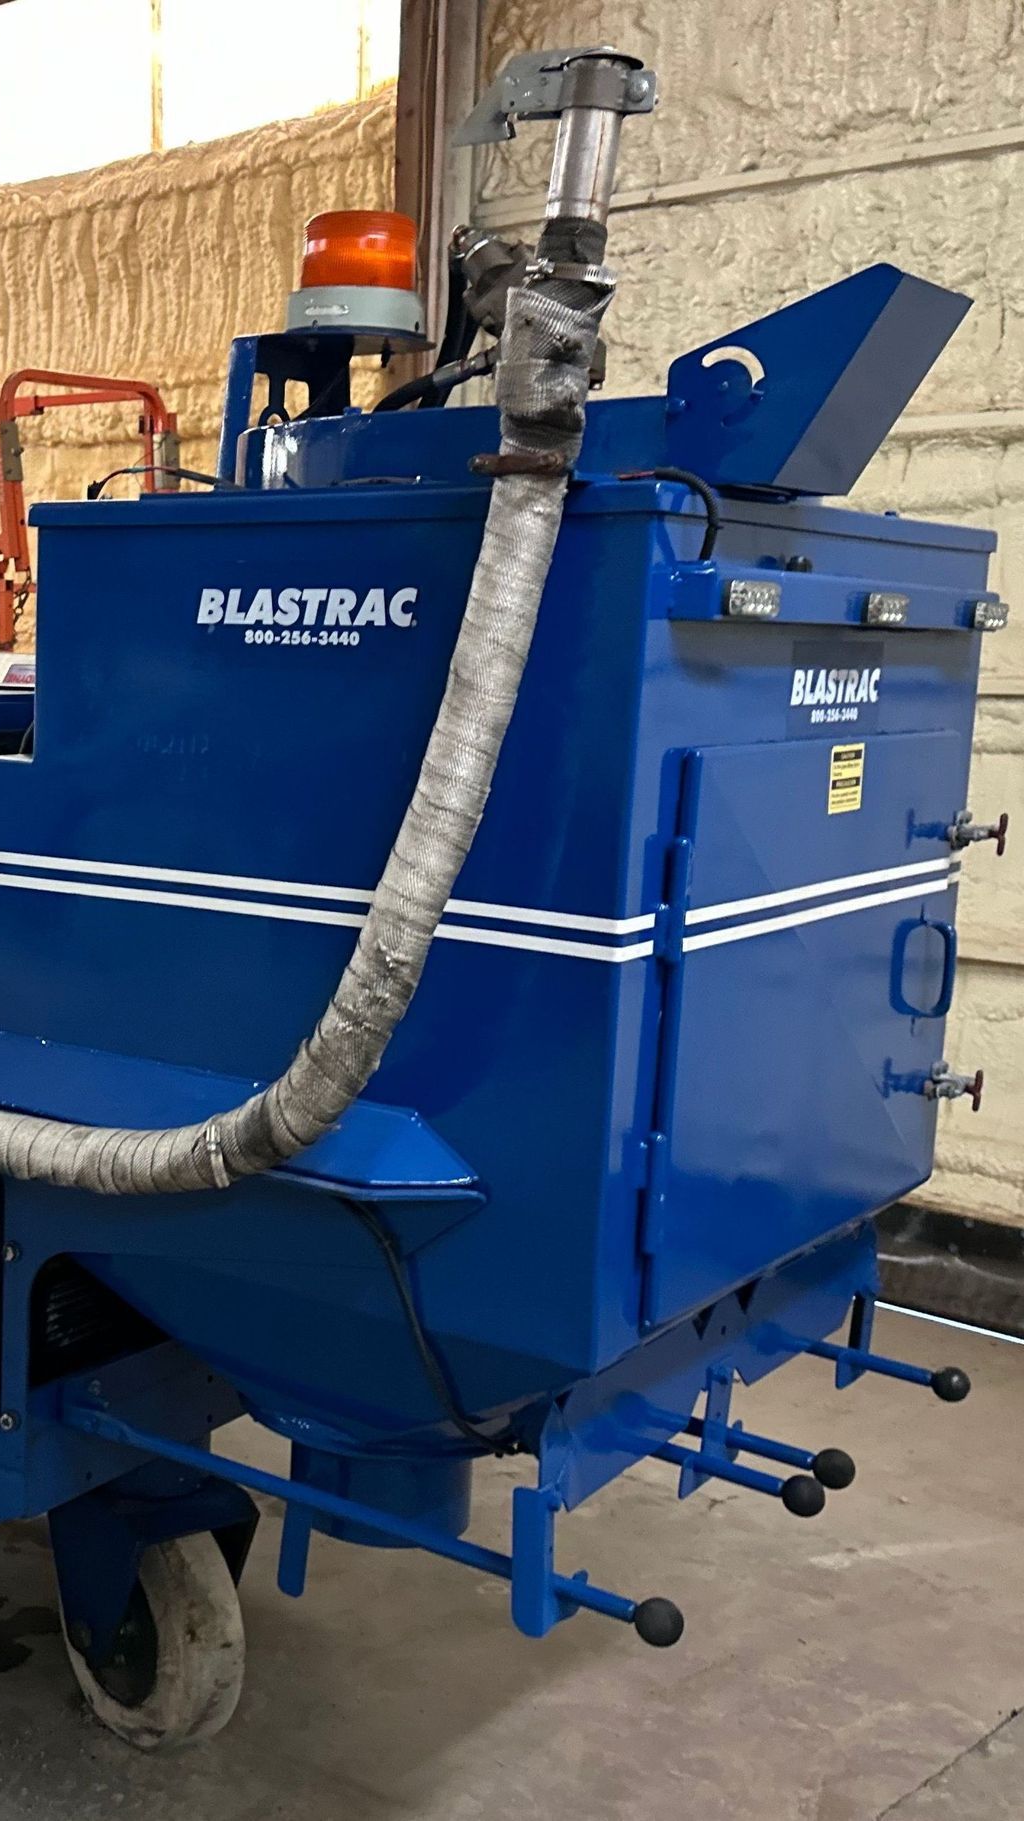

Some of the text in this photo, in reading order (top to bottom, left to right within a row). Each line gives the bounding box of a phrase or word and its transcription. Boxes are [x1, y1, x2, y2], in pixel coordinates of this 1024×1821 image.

[197, 587, 418, 627] BLASTRAC
[244, 629, 360, 646] 800-256-3440
[790, 667, 881, 706] BLASTRAC
[810, 707, 858, 724] 800-256-3440
